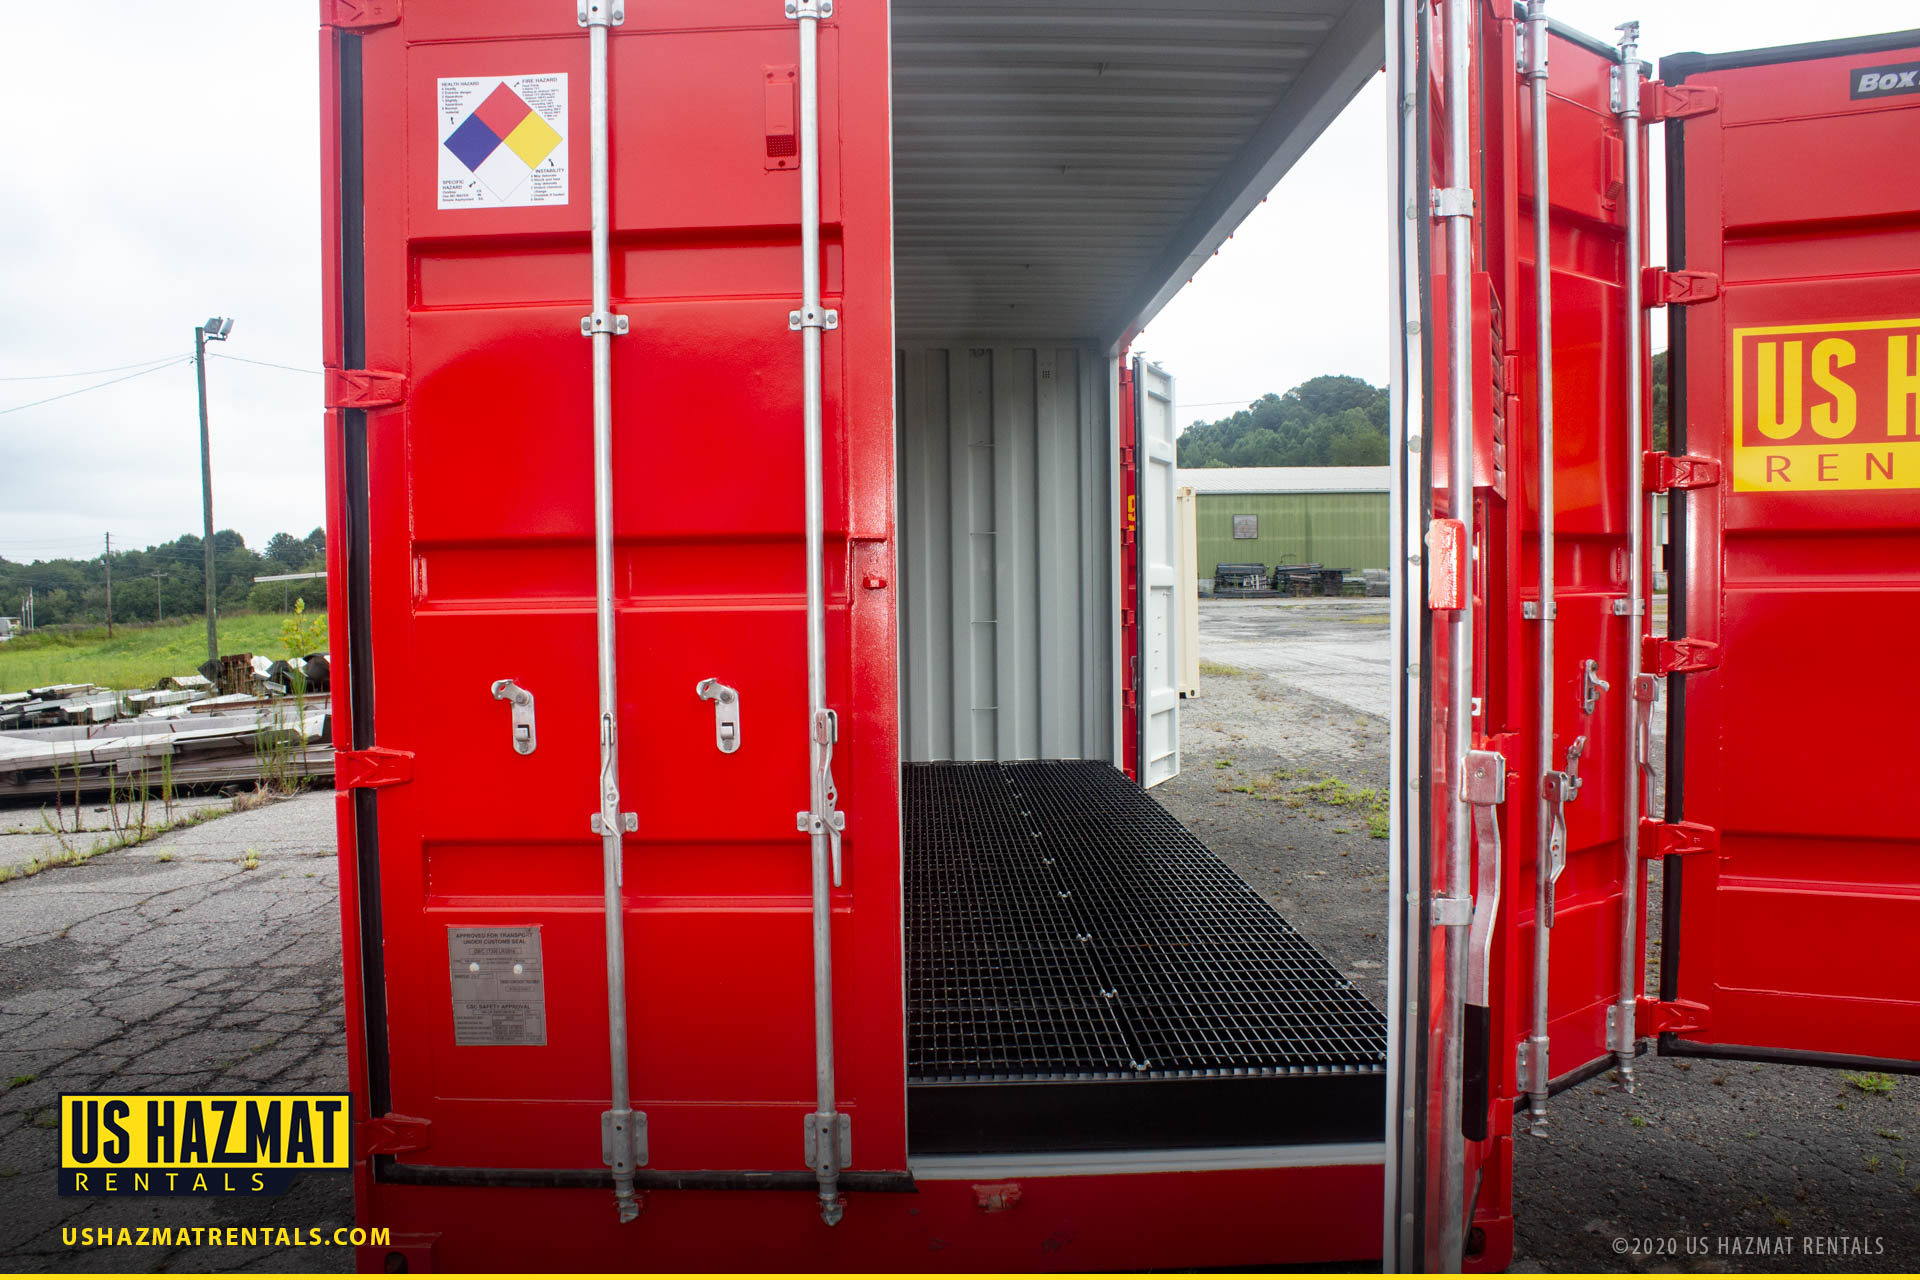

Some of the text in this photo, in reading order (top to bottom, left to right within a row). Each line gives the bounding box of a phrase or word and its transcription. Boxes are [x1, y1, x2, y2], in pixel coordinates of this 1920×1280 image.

[1857, 70, 1920, 93] BOX
[1757, 338, 1857, 440] US
[1766, 452, 1894, 483] REN
